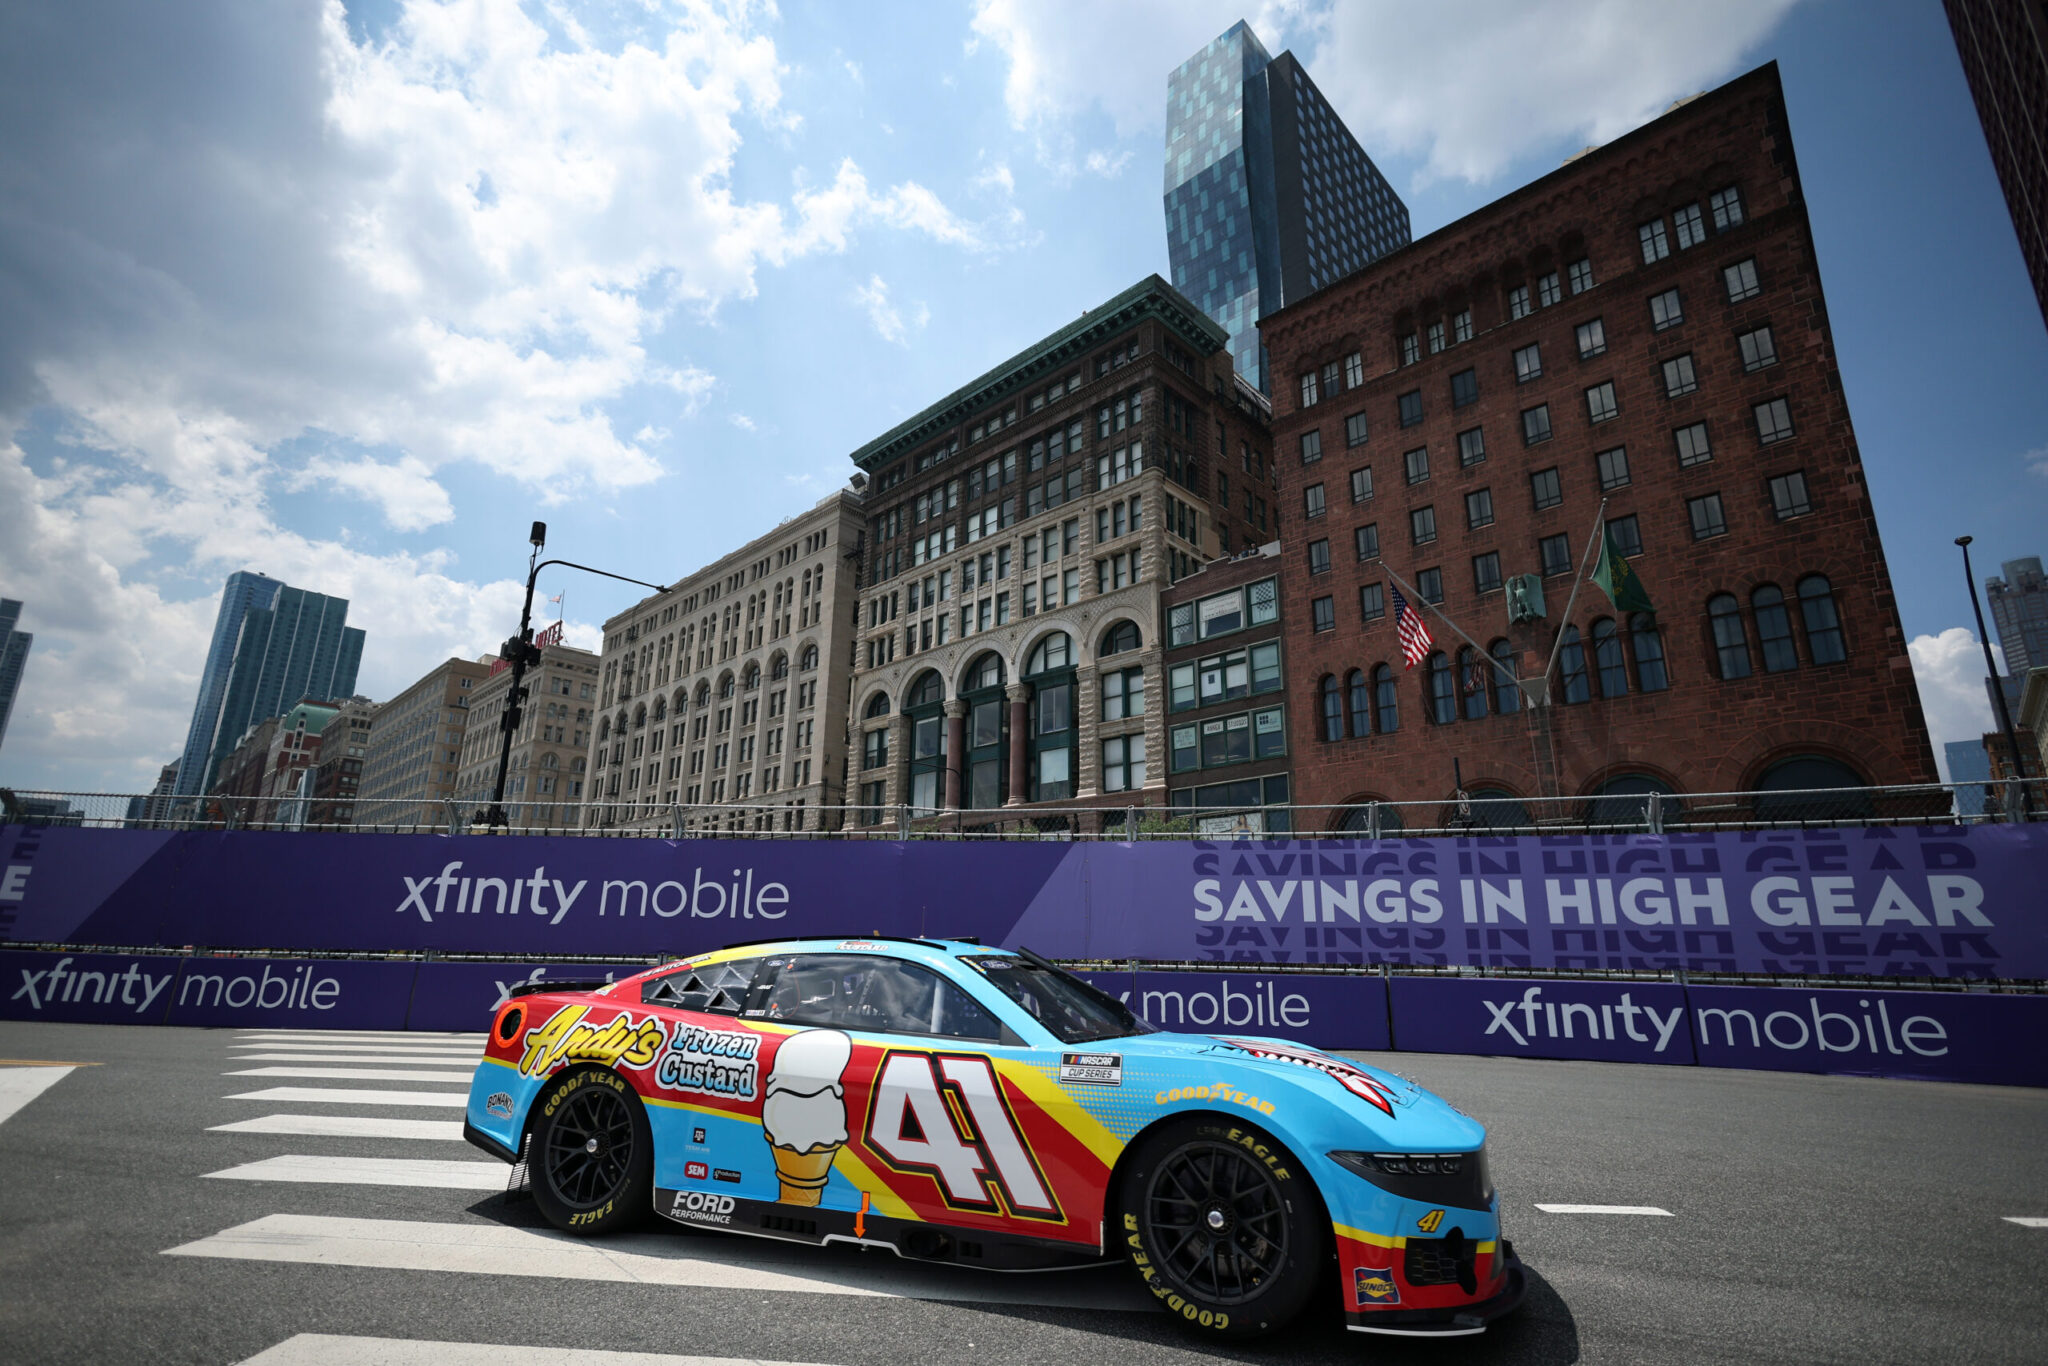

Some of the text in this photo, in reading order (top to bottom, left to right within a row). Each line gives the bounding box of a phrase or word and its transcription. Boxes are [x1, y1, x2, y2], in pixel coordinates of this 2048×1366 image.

[396, 860, 790, 925] xfinity mobile
[1192, 875, 1994, 928] SAVINGS IN HIGH GEAR
[11, 957, 340, 1013] xfinity mobile
[1142, 980, 1311, 1028] mobile
[519, 1004, 664, 1077] Andy's
[672, 1022, 757, 1060] Frozen
[1484, 985, 1949, 1056] xfinity mobile
[659, 1053, 755, 1097] Custard
[1068, 1068, 1113, 1079] CUP SERIES
[1079, 1055, 1114, 1066] NASCAR
[862, 1049, 1067, 1225] 41
[1226, 1128, 1292, 1183] EAGLE
[687, 1164, 705, 1178] SEM
[568, 1199, 614, 1226] EAGLE
[670, 1208, 732, 1225] PERFORMANCE
[673, 1190, 736, 1215] FORD
[1416, 1209, 1447, 1234] 41
[1357, 1281, 1396, 1293] SUNOCO
